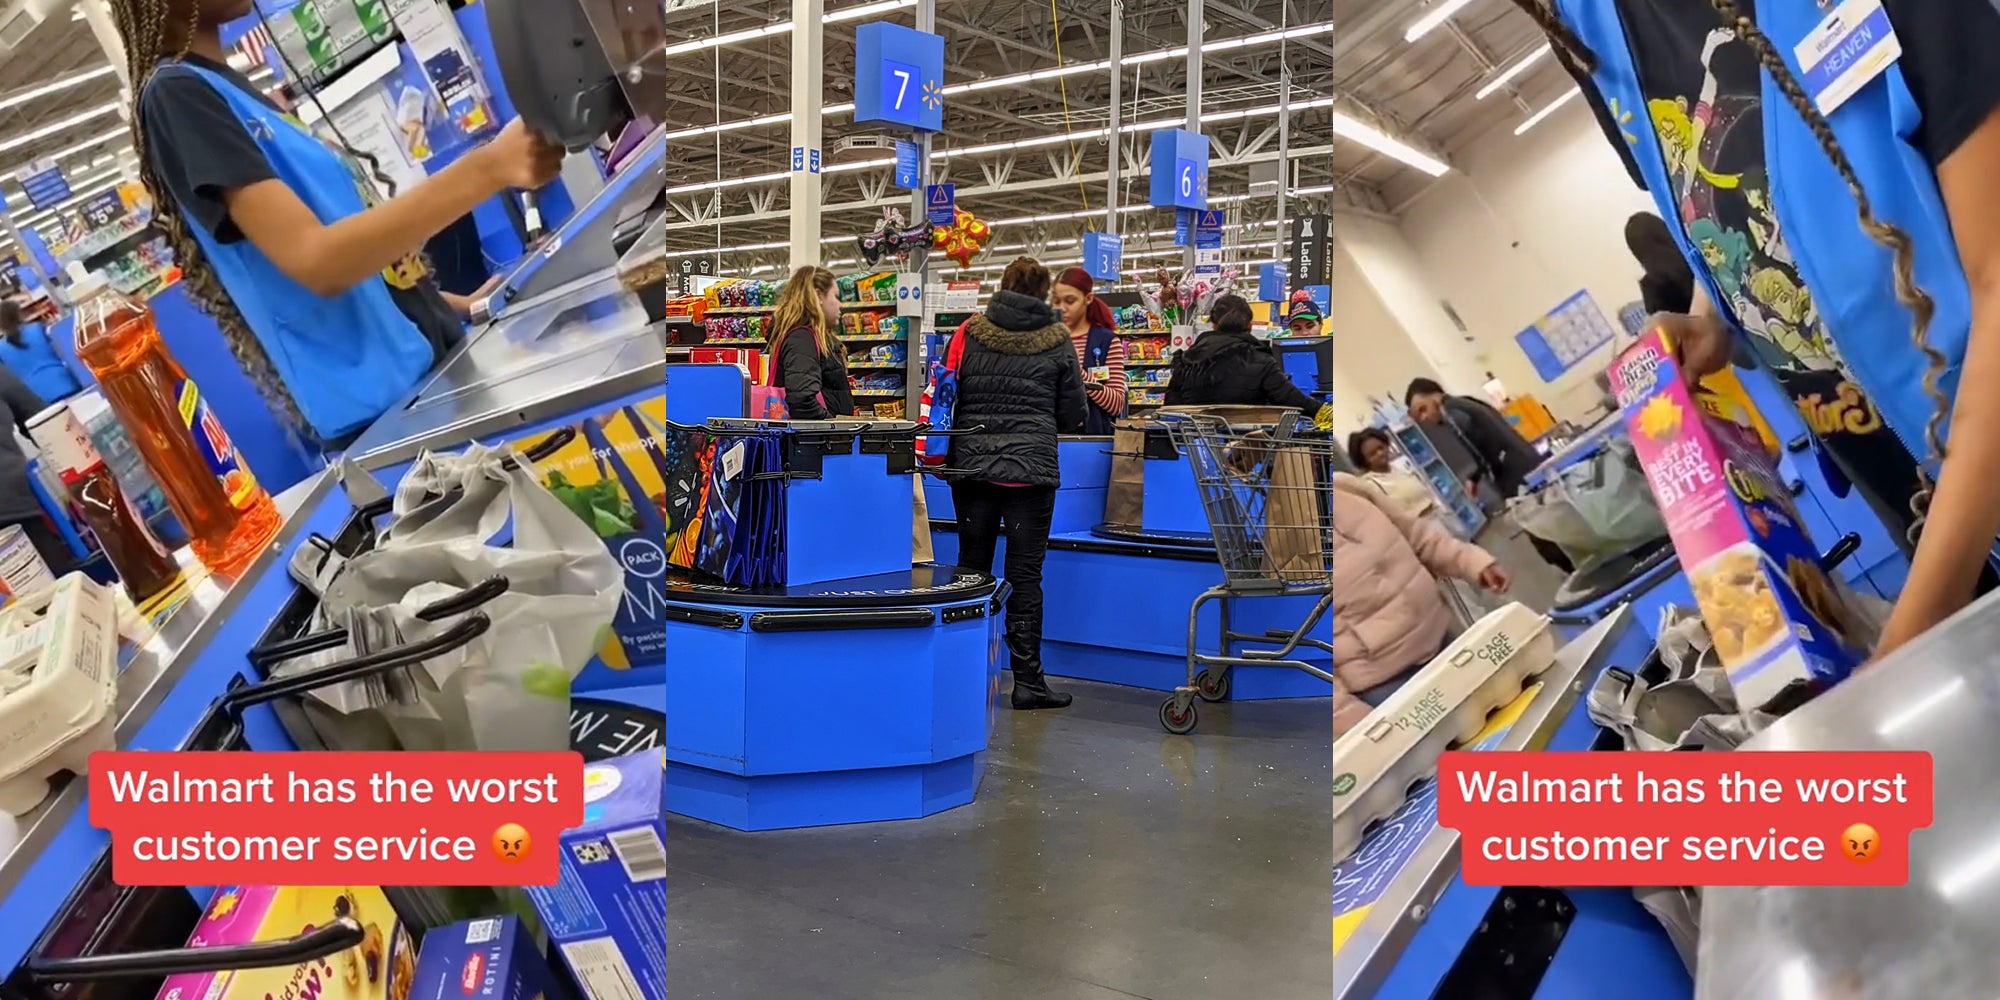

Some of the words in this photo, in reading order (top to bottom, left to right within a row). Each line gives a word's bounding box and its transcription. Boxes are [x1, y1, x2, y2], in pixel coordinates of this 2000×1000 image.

[1823, 25, 1873, 76] HEAVEN
[893, 70, 910, 110] 7
[1181, 166, 1191, 197] 6
[1101, 254, 1108, 273] 3
[1300, 242, 1312, 279] Ladies
[592, 446, 612, 460] for
[1647, 446, 1681, 474] BEST
[1681, 436, 1700, 454] IN
[1654, 446, 1705, 488] EVERY
[1657, 461, 1716, 508] BITE
[627, 551, 661, 566] PACK
[1477, 631, 1509, 660] CAGE
[1489, 642, 1515, 666] FREE
[1395, 716, 1410, 731] 12
[1408, 688, 1444, 719] LARGE
[1412, 702, 1447, 731] WHITE
[482, 946, 501, 995] ROTINI
